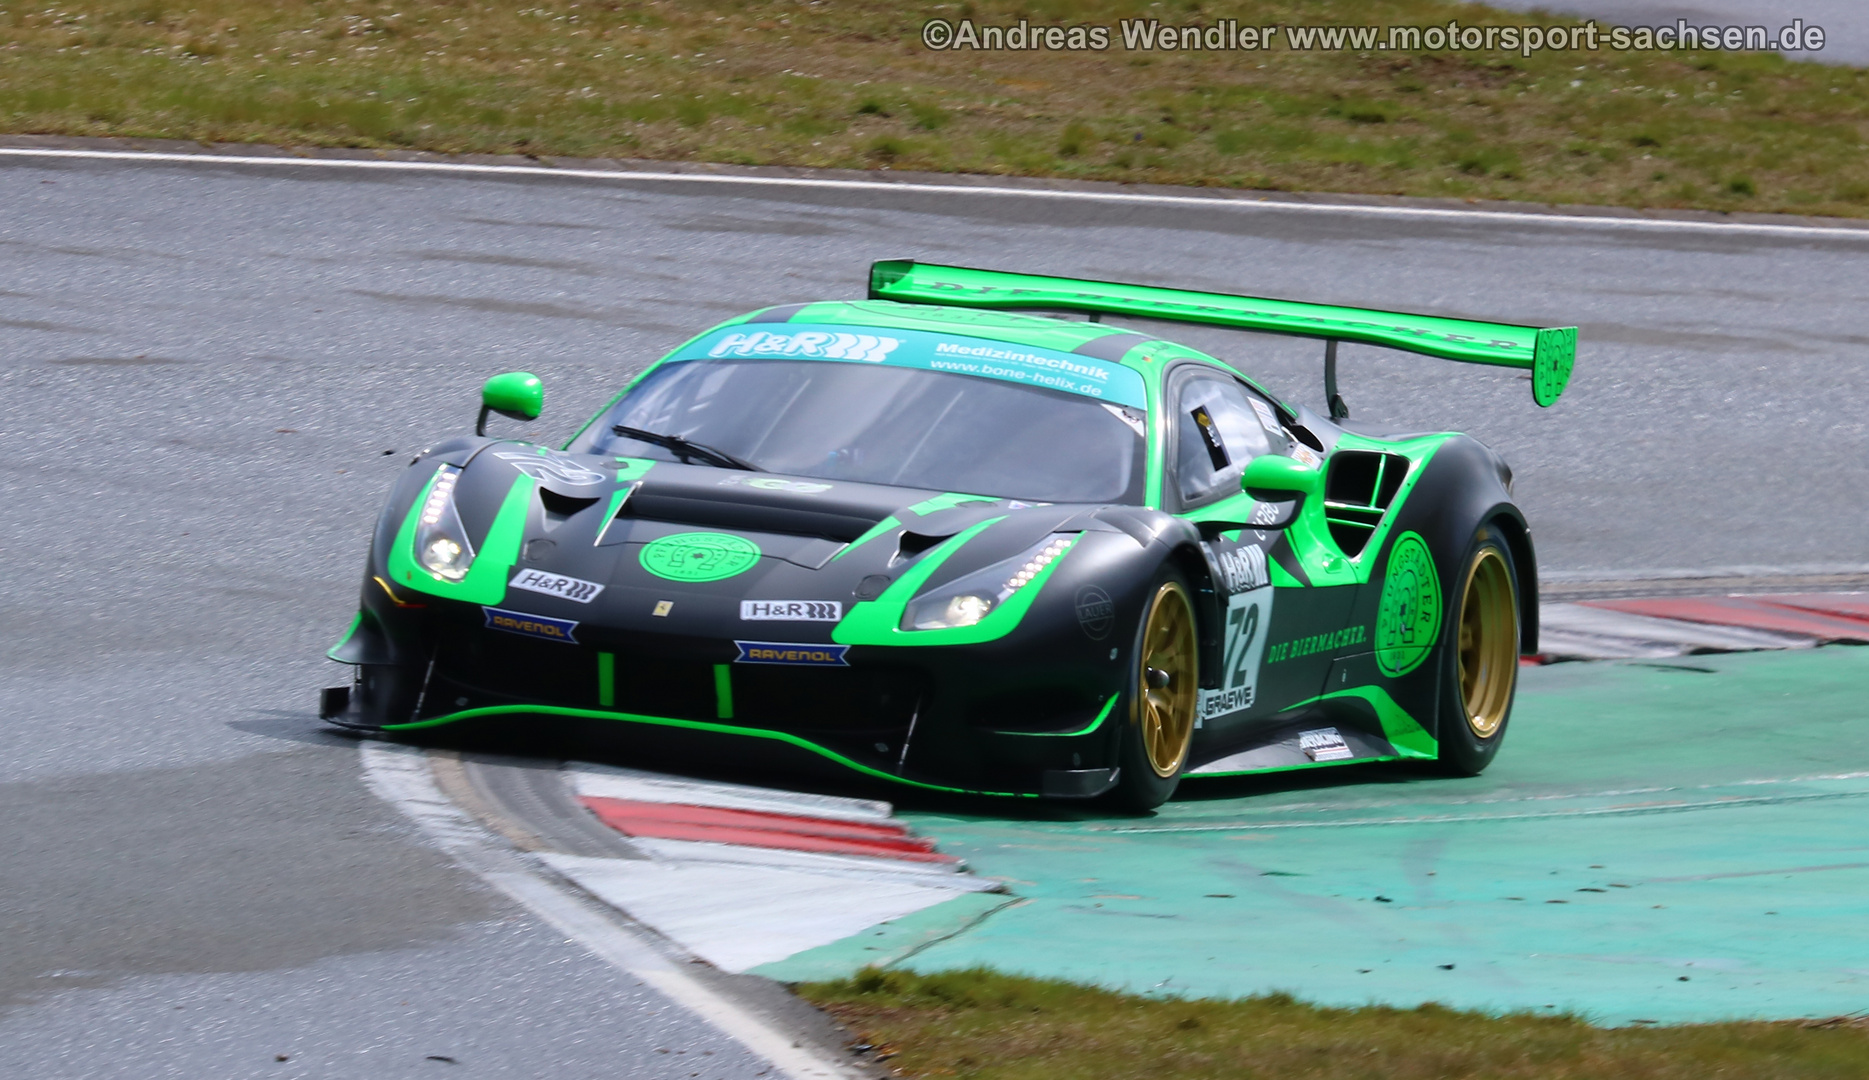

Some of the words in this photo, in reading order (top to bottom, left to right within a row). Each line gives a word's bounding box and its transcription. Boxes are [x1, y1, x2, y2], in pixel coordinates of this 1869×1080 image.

[935, 342, 1110, 381] Medizintechnik
[930, 359, 1103, 397] www.bone-helix.de
[521, 572, 569, 592] H&R
[752, 603, 803, 616] H&R
[1079, 603, 1113, 619] LAUER
[493, 615, 566, 637] RAVENOL
[748, 648, 836, 662] RAVENOL
[1222, 602, 1260, 691] 72
[1267, 642, 1289, 664] DIE
[1205, 686, 1253, 716] GRAEWE
